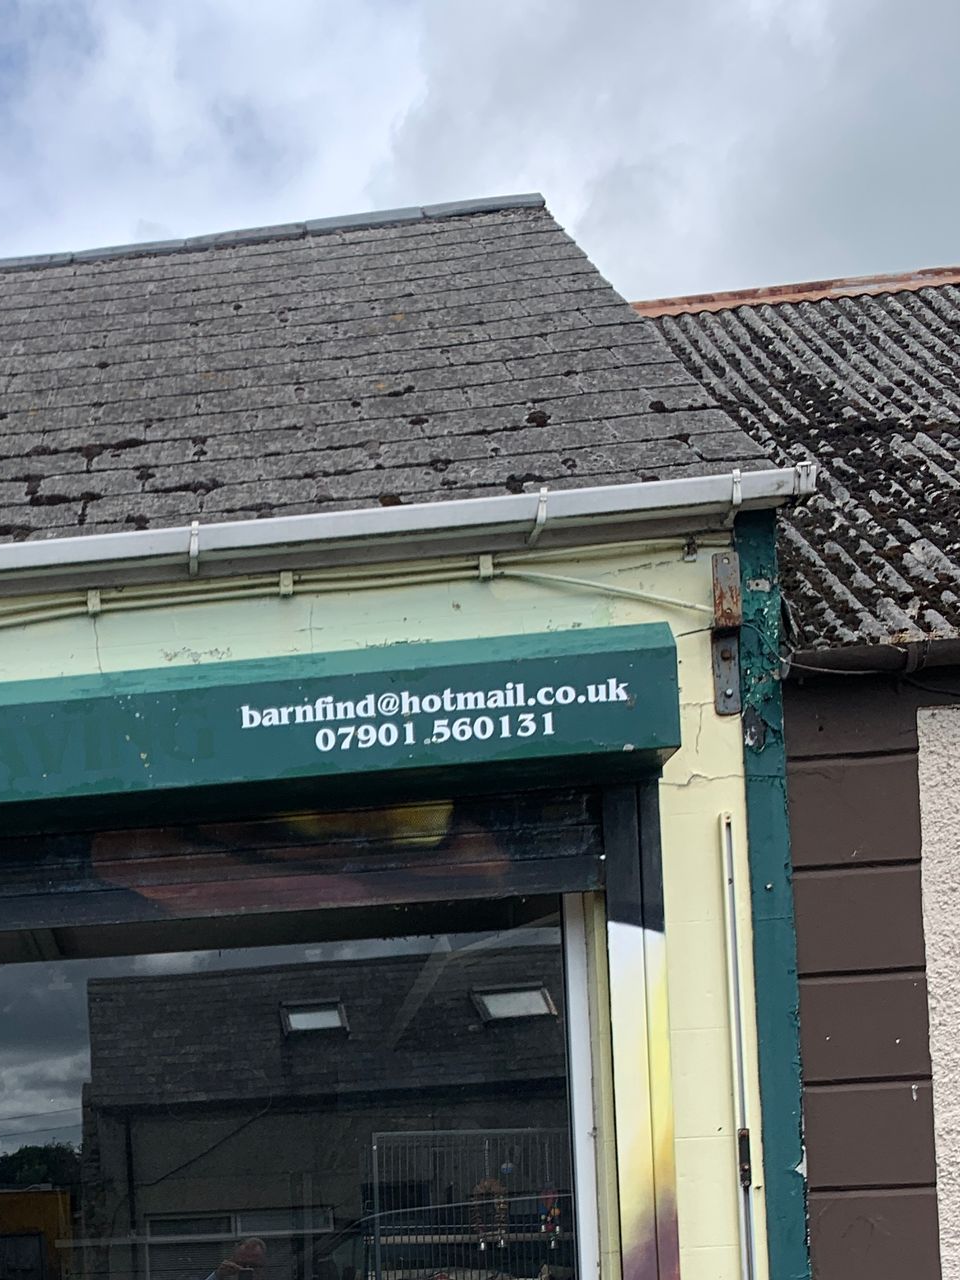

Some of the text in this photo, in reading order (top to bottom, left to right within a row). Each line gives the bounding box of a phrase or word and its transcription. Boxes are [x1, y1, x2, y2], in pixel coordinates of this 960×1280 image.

[240, 678, 629, 728] barnfind@hotmail.co.uk
[315, 712, 555, 752] 07901 560131
